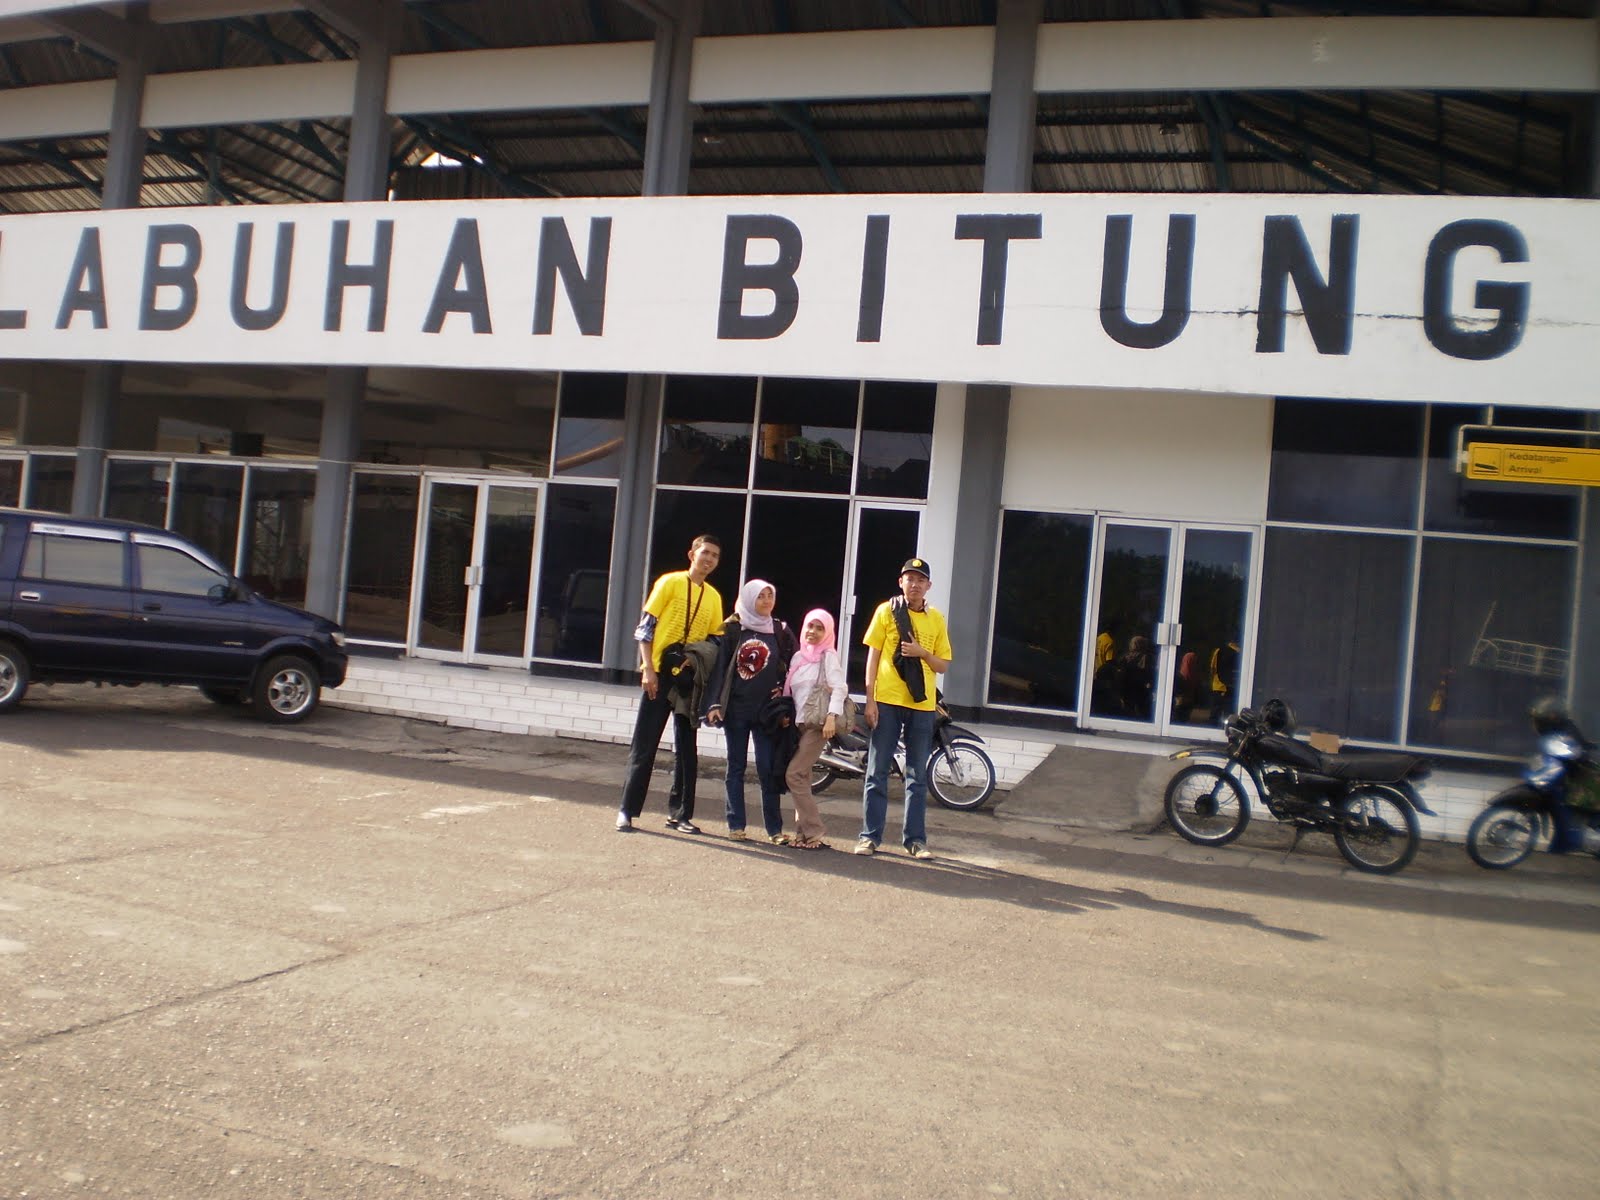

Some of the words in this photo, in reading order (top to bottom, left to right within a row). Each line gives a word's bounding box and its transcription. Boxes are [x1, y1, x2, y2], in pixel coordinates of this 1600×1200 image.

[718, 214, 1530, 360] BITUNG
[1508, 452, 1569, 464] Kedatangan
[1508, 465, 1543, 474] Arrival
